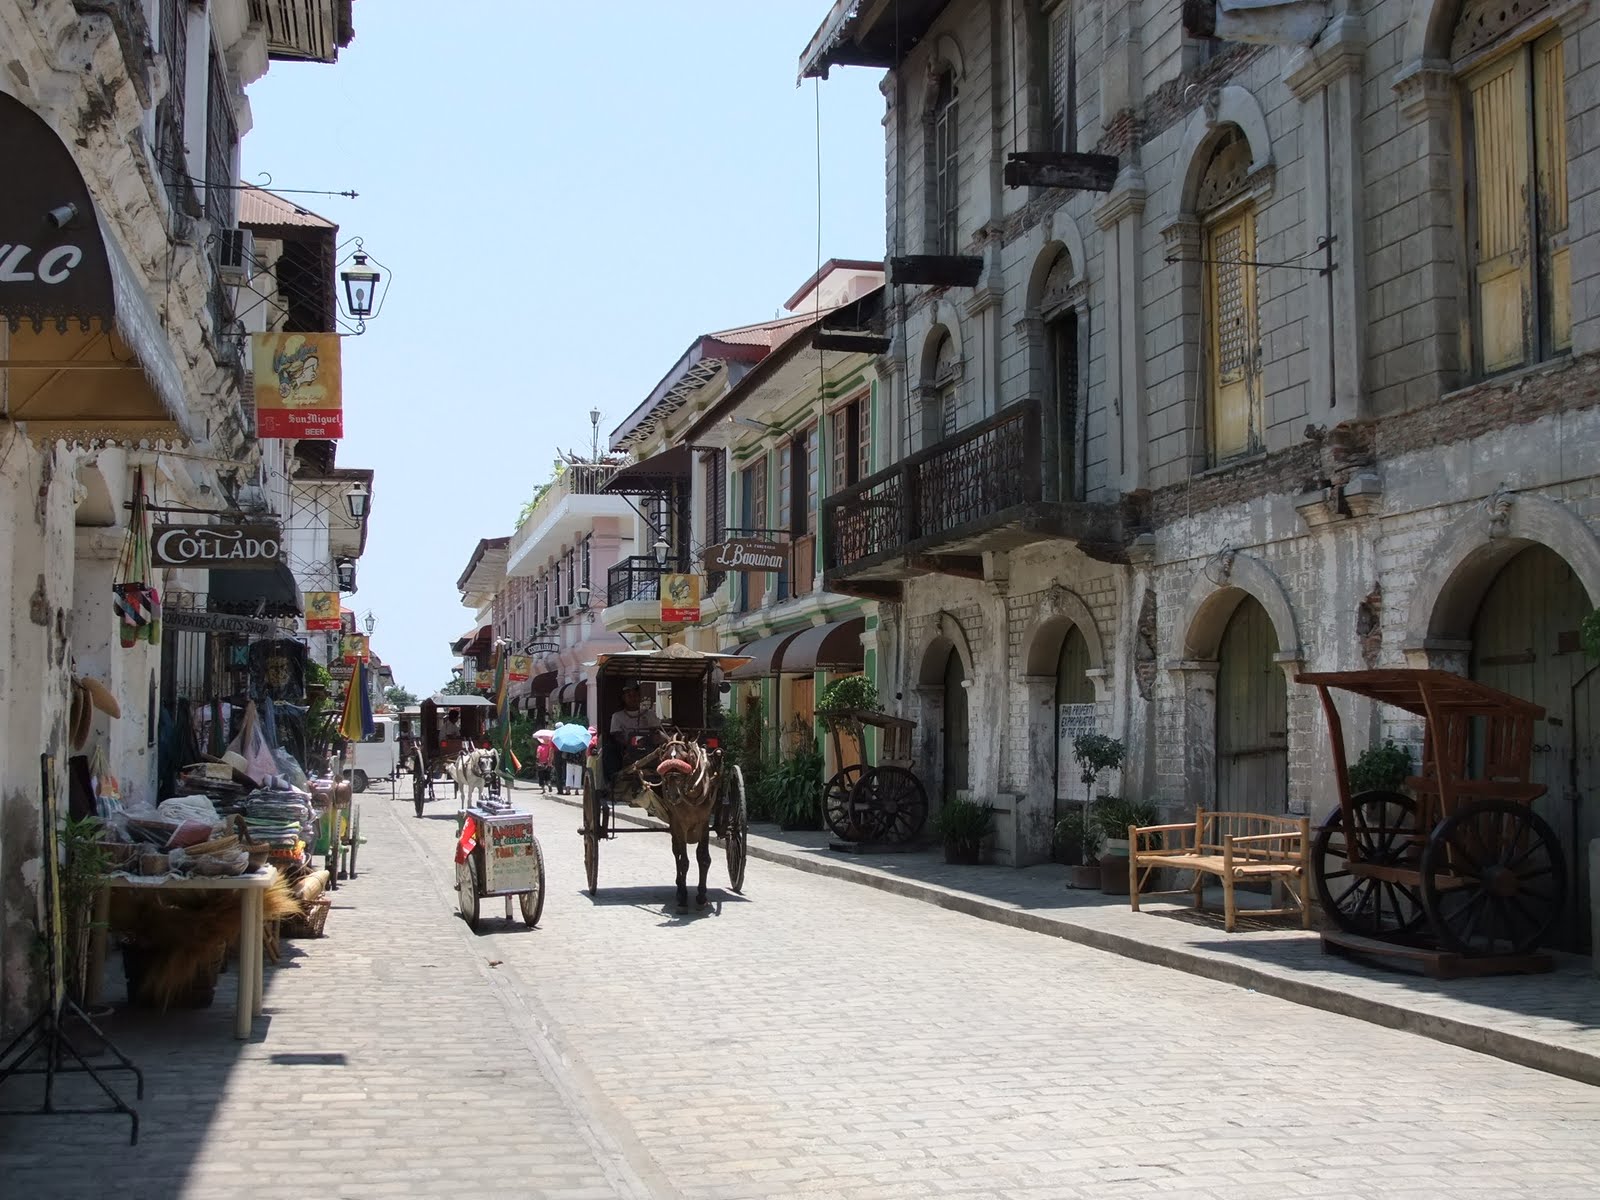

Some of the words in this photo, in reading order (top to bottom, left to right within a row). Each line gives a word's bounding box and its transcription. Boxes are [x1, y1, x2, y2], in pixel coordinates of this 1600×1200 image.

[157, 529, 278, 563] COLLADO
[218, 618, 244, 632] ARTS
[244, 621, 269, 635] SHOP
